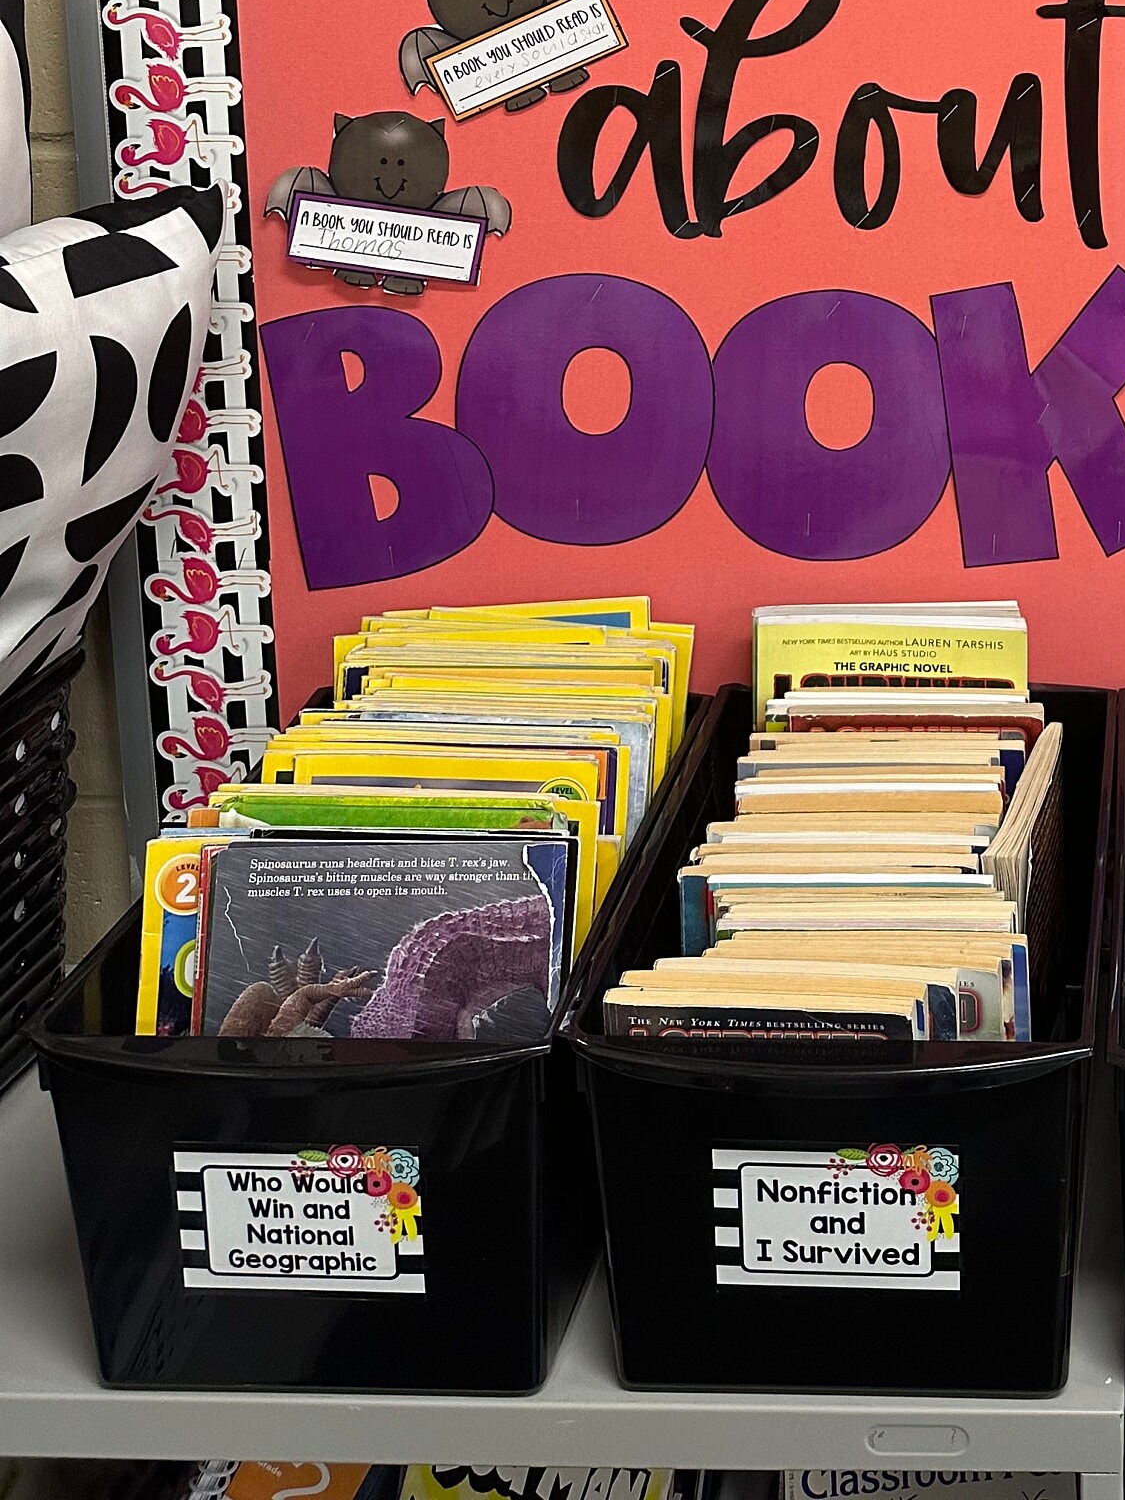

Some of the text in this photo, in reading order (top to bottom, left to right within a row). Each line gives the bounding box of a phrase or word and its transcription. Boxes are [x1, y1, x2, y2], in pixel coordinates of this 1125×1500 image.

[300, 210, 473, 248] A BOOK YOU SHOULD READ IS
[872, 649, 898, 658] HAUS
[901, 650, 937, 658] STUDIO
[905, 638, 951, 648] LAUREN
[956, 639, 1004, 650] TARSHIS
[834, 661, 953, 674] THE GRAPHIC NOVEL
[176, 863, 199, 872] LEVEL
[250, 857, 510, 871] Spinosaurus runs headfirst and bites T. rex's jaw.
[175, 873, 197, 903] 2
[248, 872, 323, 885] Spinosaurus's
[326, 872, 358, 884] biting
[360, 872, 402, 882] muscles
[404, 873, 421, 881] are
[425, 873, 446, 883] way
[449, 873, 493, 883] stronger
[495, 871, 519, 881] than
[247, 885, 448, 898] muscles T. rex uses to open its mouth.
[227, 1170, 367, 1194] Who Would
[756, 1178, 917, 1206] Nonfiction
[248, 1197, 350, 1220] Win and
[247, 1223, 355, 1246] National
[810, 1212, 866, 1235] and
[228, 1249, 377, 1274] Geographic
[756, 1238, 920, 1266] I Survived
